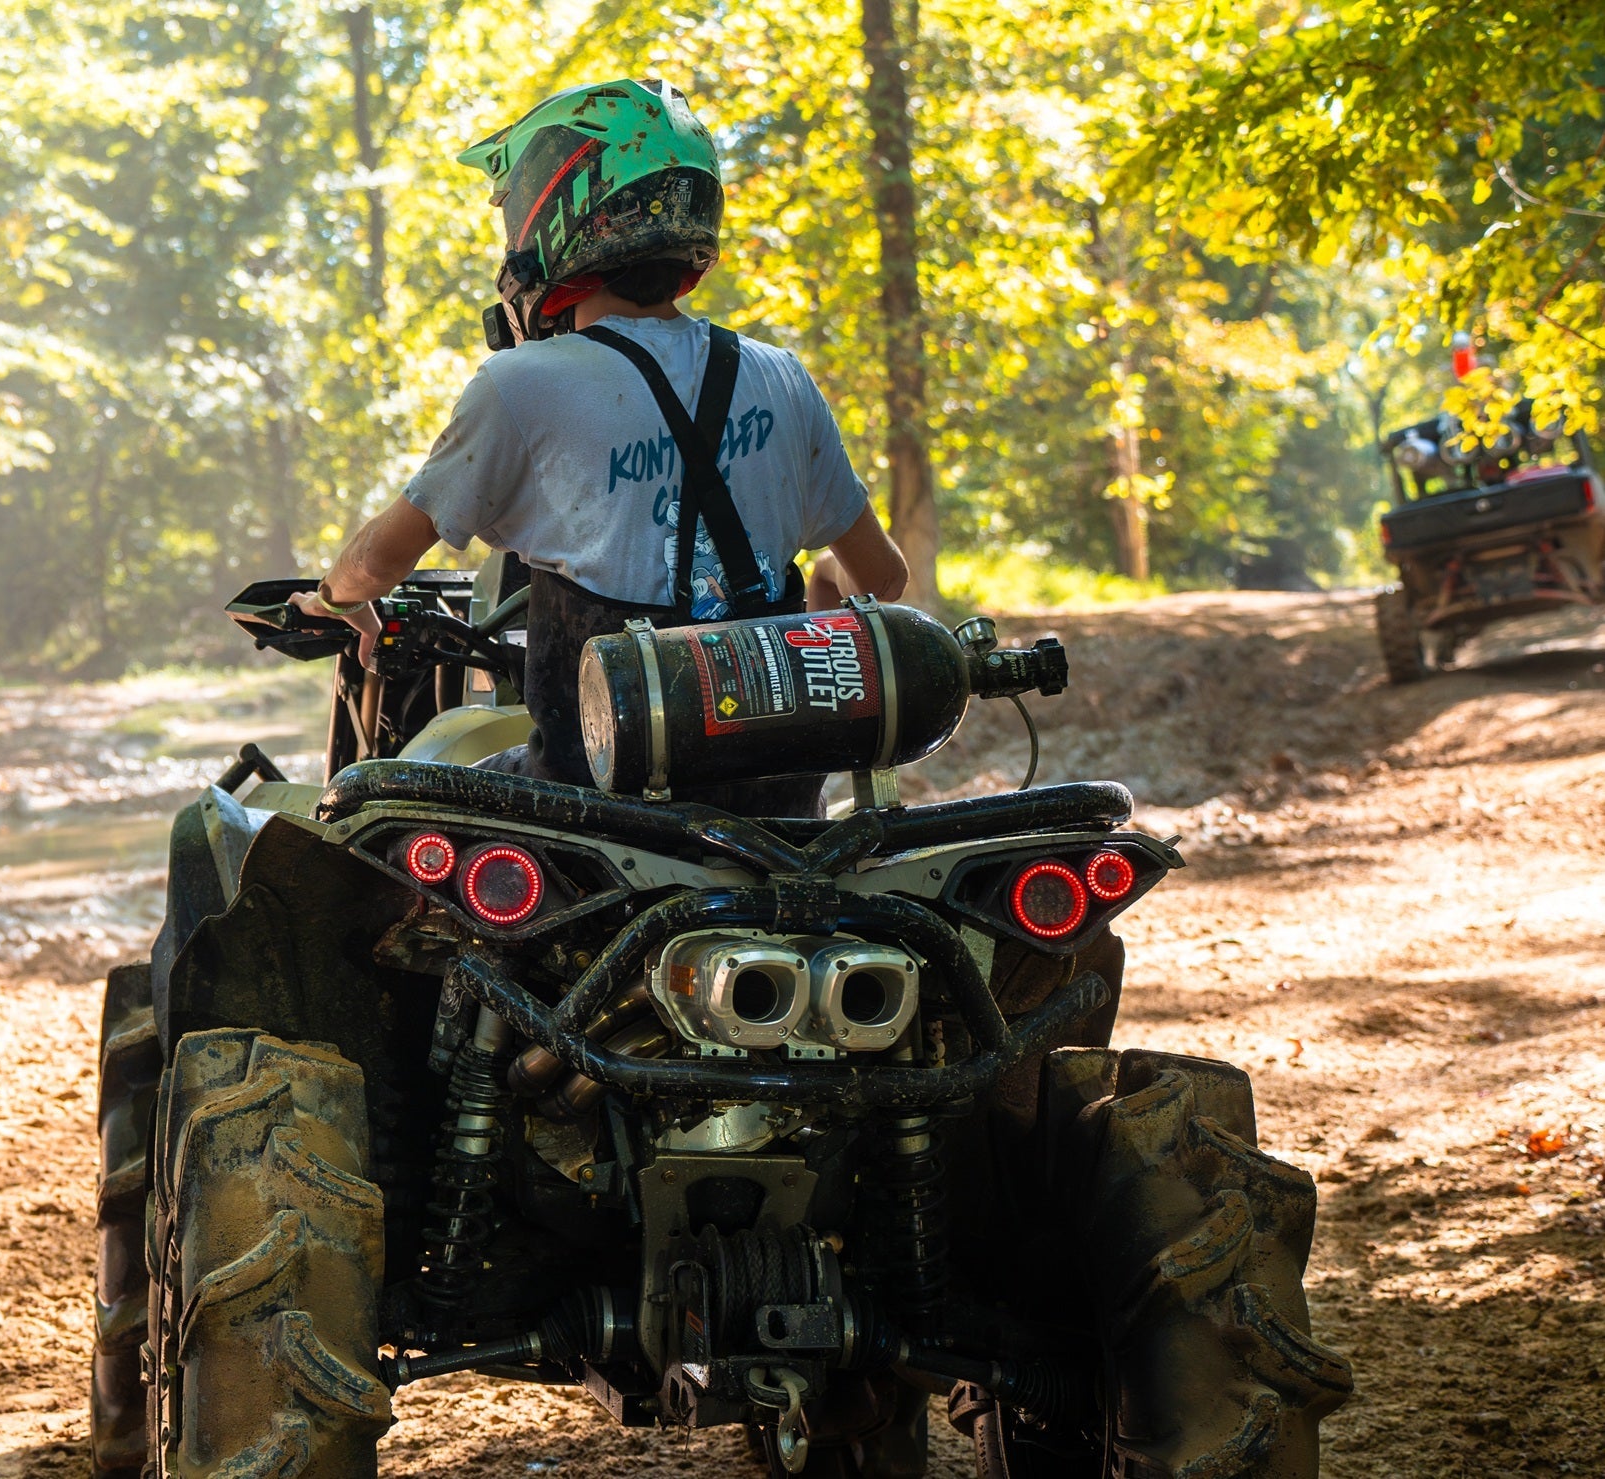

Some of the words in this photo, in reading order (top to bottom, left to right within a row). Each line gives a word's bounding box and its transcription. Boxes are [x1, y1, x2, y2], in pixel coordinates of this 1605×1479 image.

[608, 405, 774, 494] KONTLED
[785, 630, 838, 711] OUTLET
[809, 616, 865, 700] NITROUS
